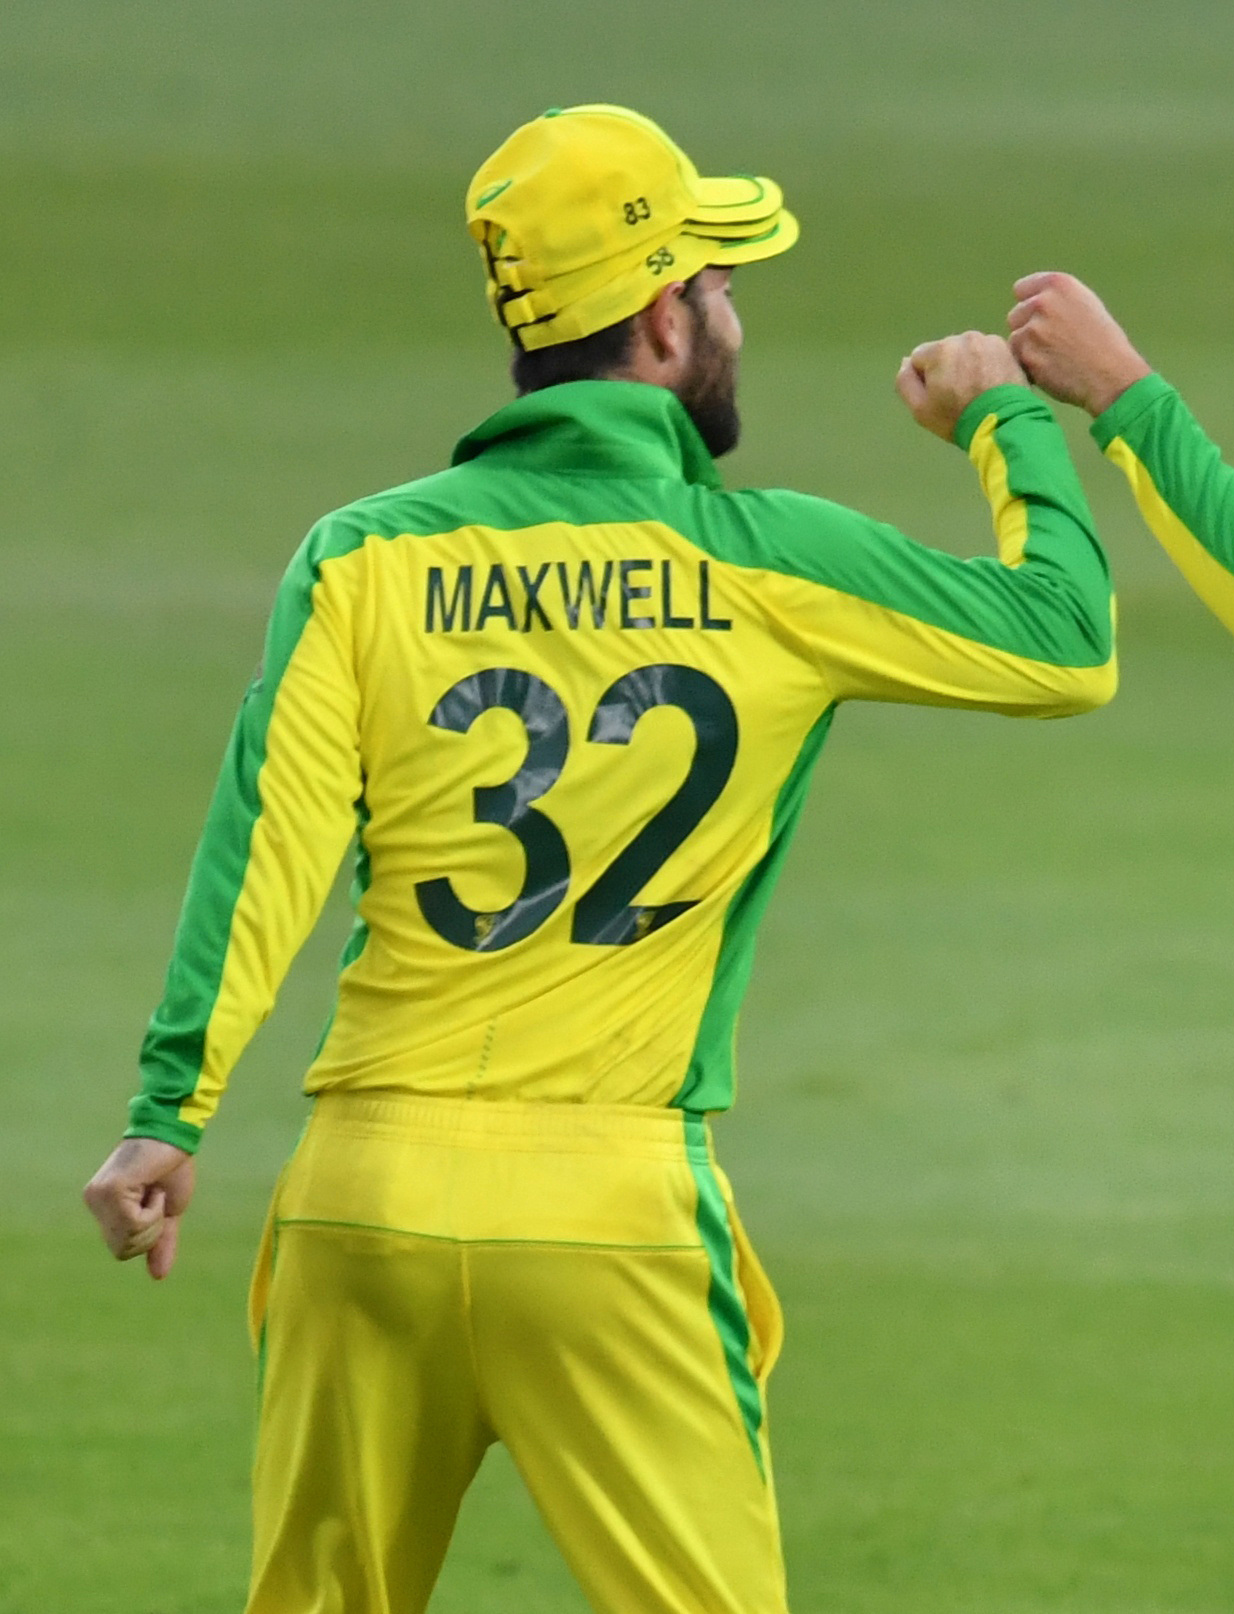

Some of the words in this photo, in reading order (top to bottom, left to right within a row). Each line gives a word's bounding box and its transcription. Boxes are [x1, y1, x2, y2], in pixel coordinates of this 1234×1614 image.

[623, 196, 651, 226] 83
[646, 246, 675, 275] 58
[425, 559, 733, 634] MAXWELL
[413, 662, 740, 953] 32
